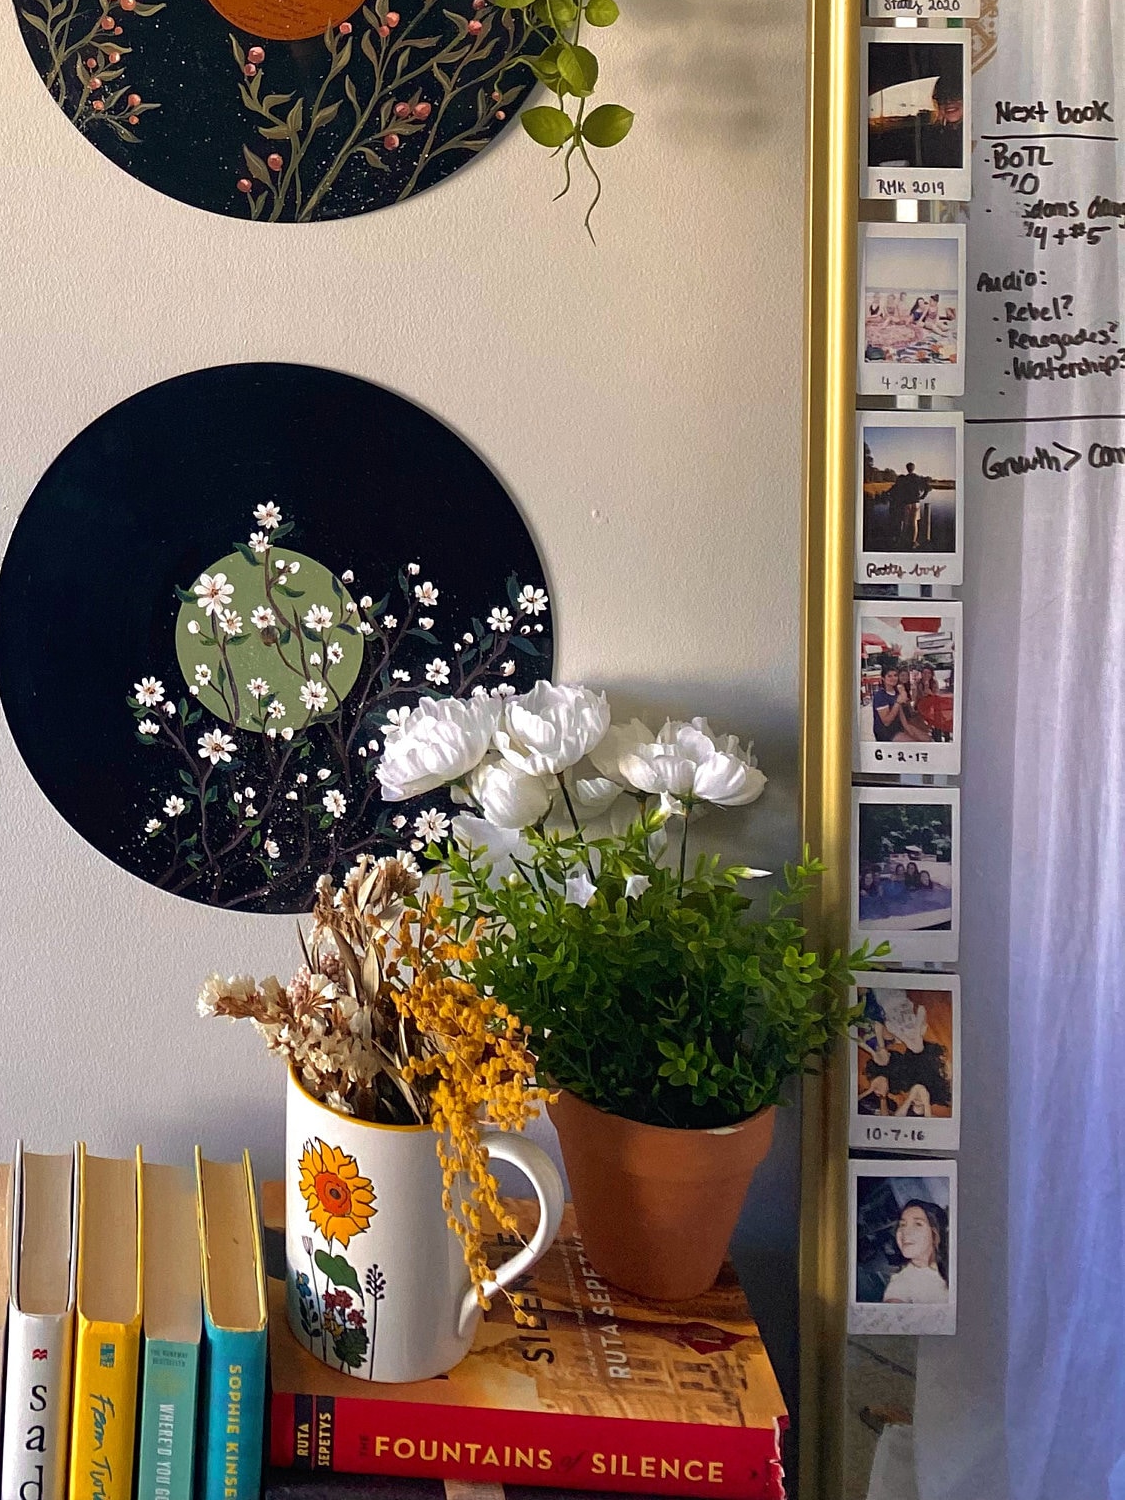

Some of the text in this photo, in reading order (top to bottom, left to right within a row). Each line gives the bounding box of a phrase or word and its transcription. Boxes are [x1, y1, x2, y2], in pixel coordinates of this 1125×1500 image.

[995, 100, 1115, 125] Next book
[912, 181, 945, 196] 2019
[977, 269, 1047, 292] Audio:
[600, 1323, 633, 1379] RUTA
[226, 1364, 242, 1434] SOPHIE
[157, 1403, 175, 1456] WHERE'D
[296, 1411, 332, 1466] RUTA SEPETYS
[155, 1461, 172, 1484] YOU
[375, 1435, 553, 1471] FOUNTAINS
[590, 1452, 725, 1484] SILENCE
